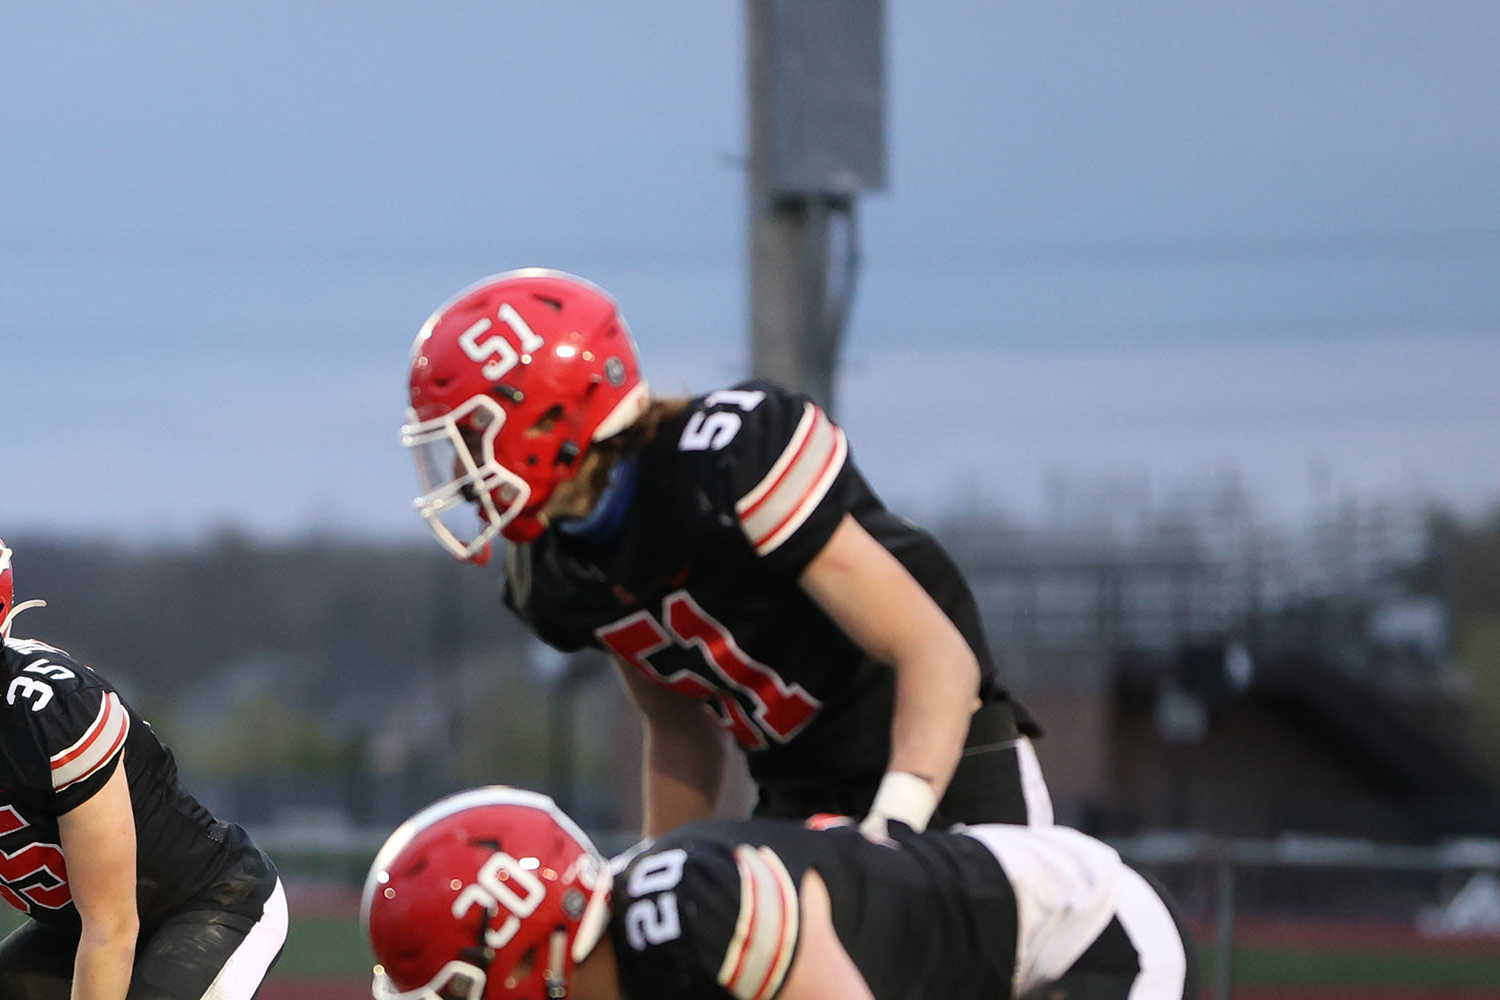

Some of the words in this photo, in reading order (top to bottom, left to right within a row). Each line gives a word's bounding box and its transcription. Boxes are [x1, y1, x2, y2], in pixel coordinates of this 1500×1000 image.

[458, 303, 545, 381] 51
[678, 390, 767, 451] 51
[6, 658, 76, 712] 35
[595, 588, 822, 752] 51
[625, 848, 689, 951] 20
